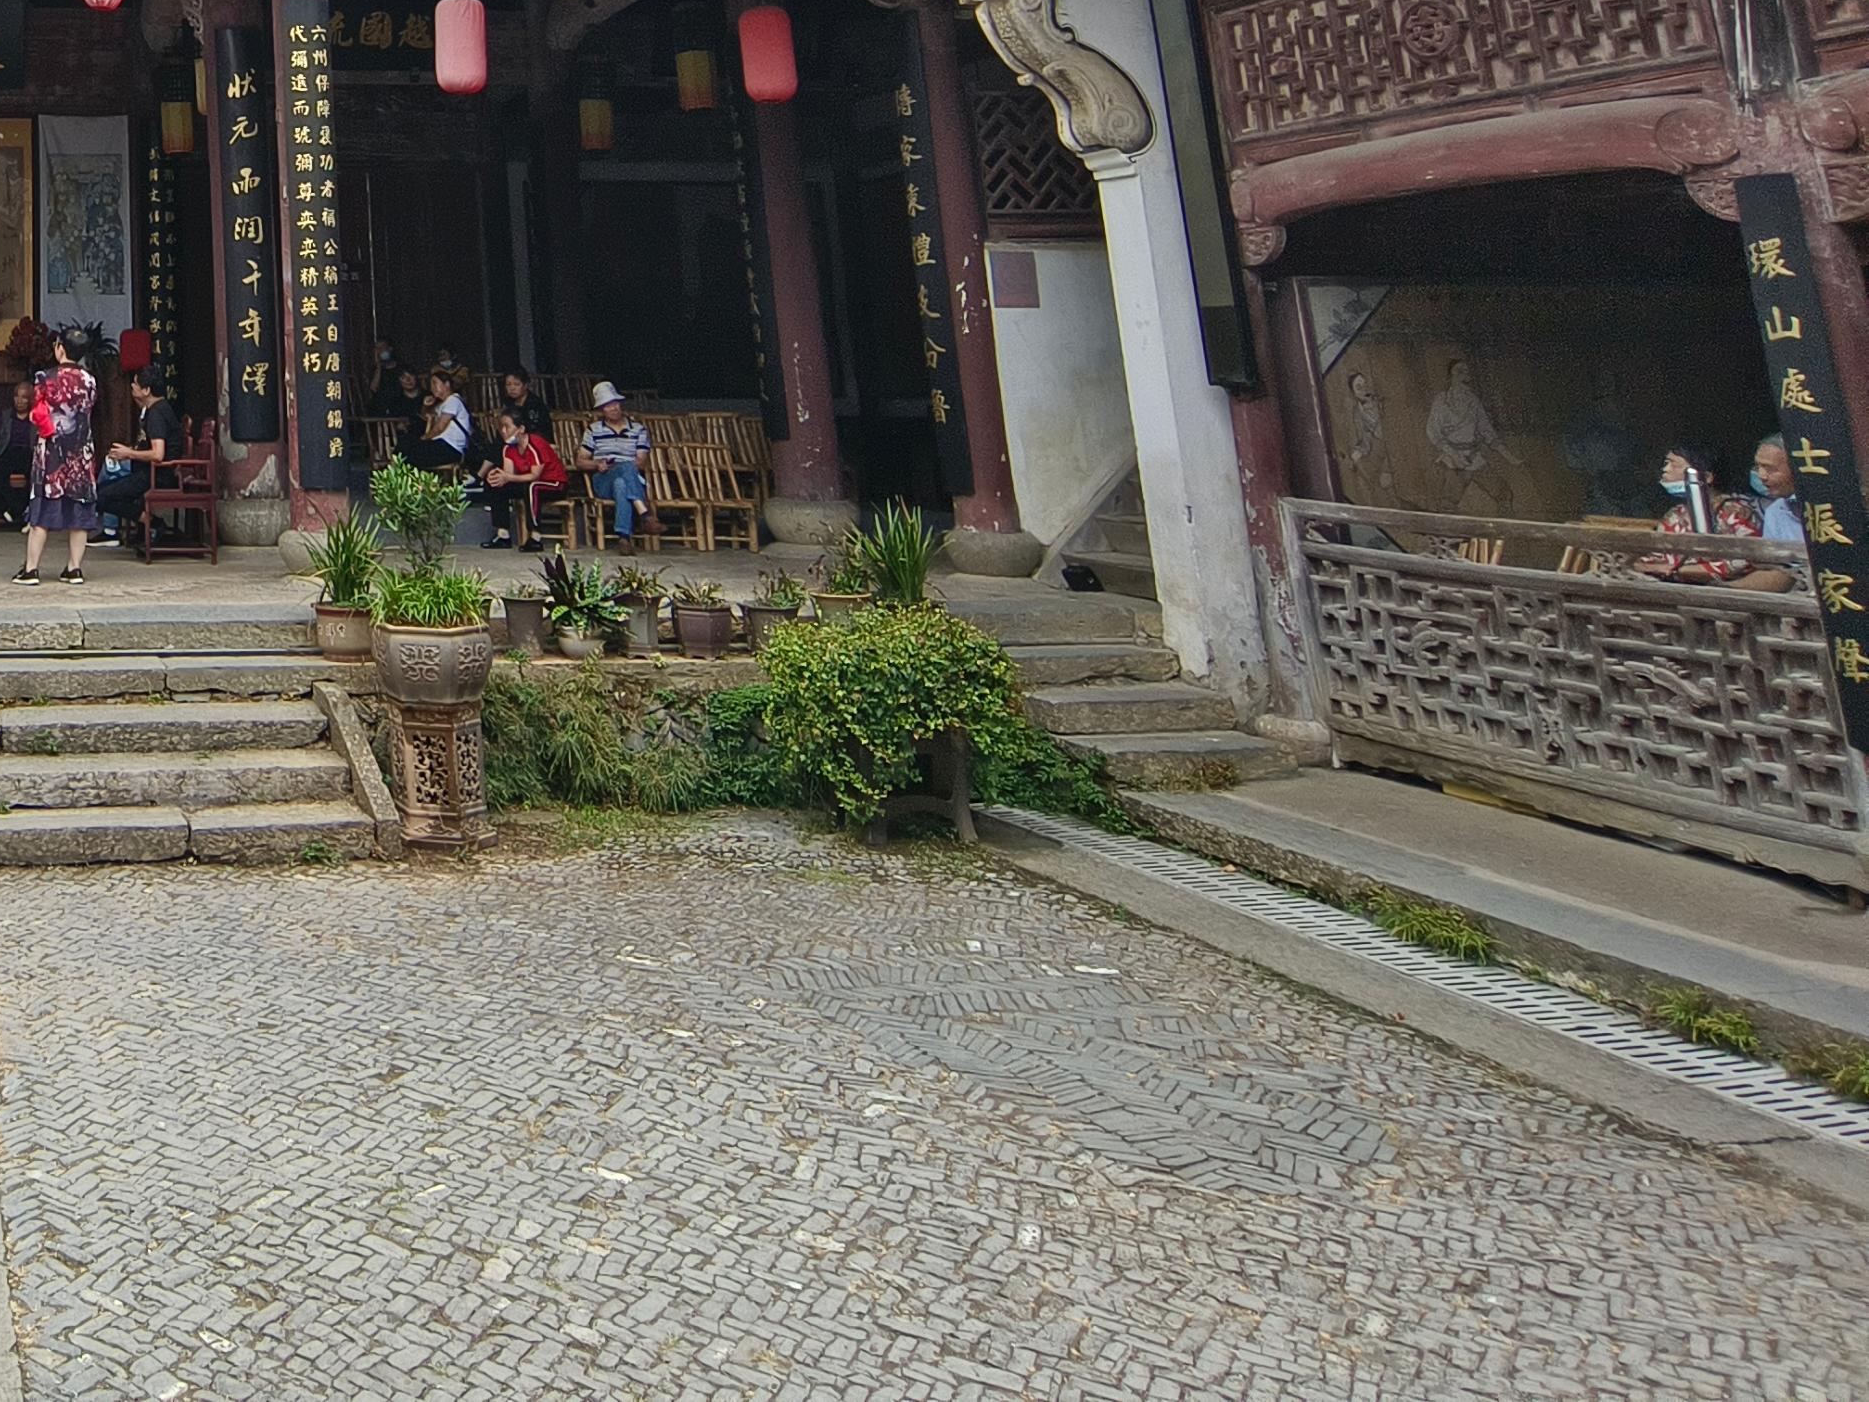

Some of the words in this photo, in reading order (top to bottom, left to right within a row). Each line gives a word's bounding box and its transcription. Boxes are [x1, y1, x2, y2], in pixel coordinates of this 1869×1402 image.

[1747, 237, 1869, 683] 環山處士振家聲
